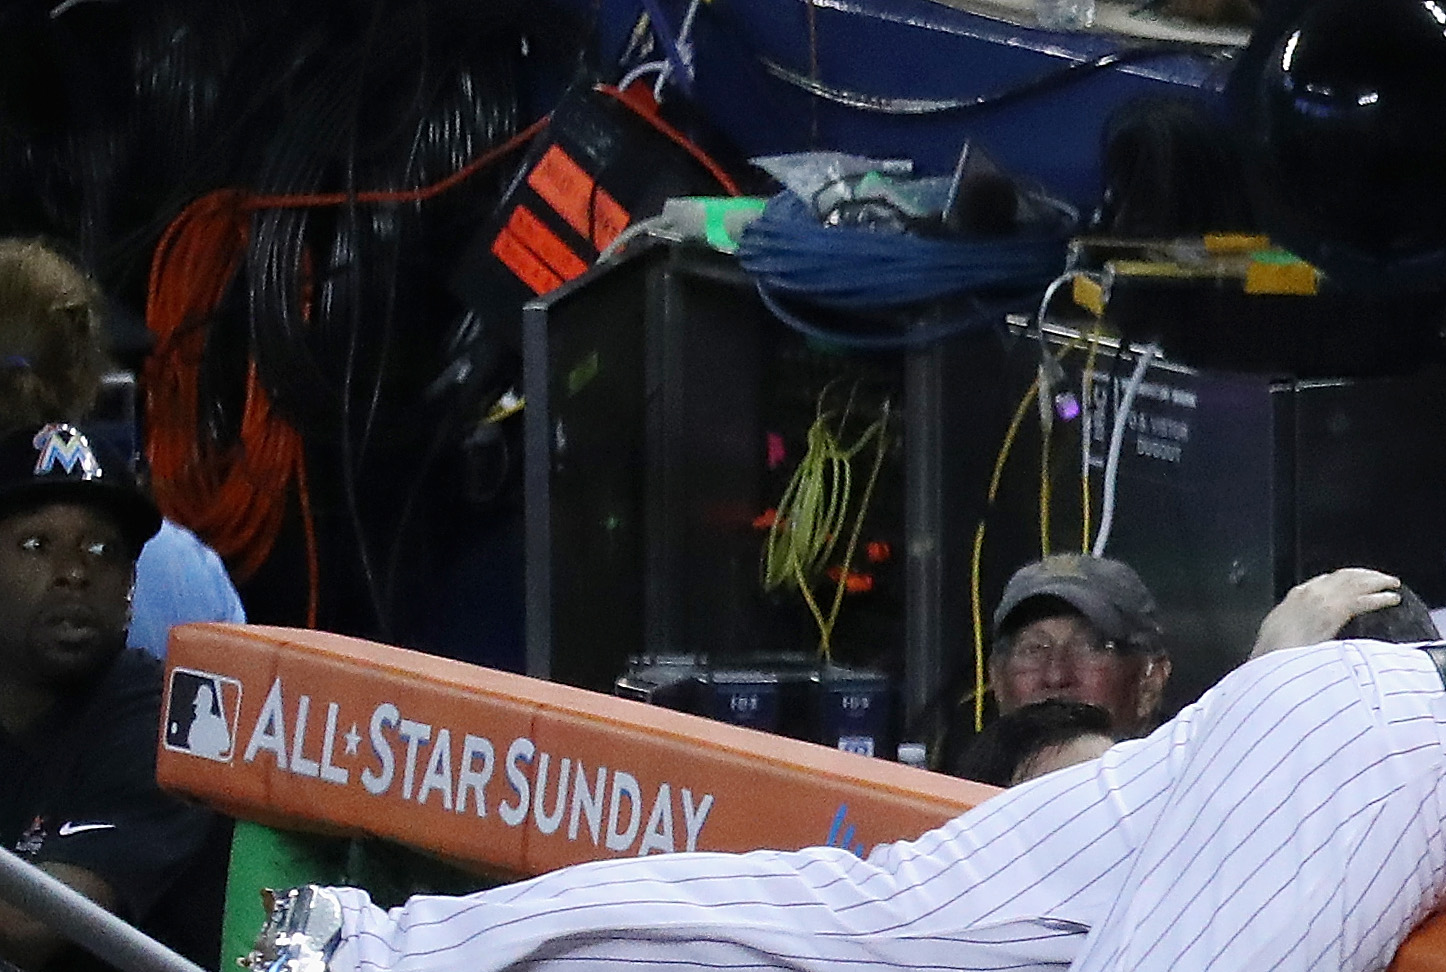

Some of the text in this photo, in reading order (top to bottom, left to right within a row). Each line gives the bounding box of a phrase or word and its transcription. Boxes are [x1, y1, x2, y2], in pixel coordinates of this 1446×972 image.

[243, 675, 715, 856] ALL STAR SUNDAY
